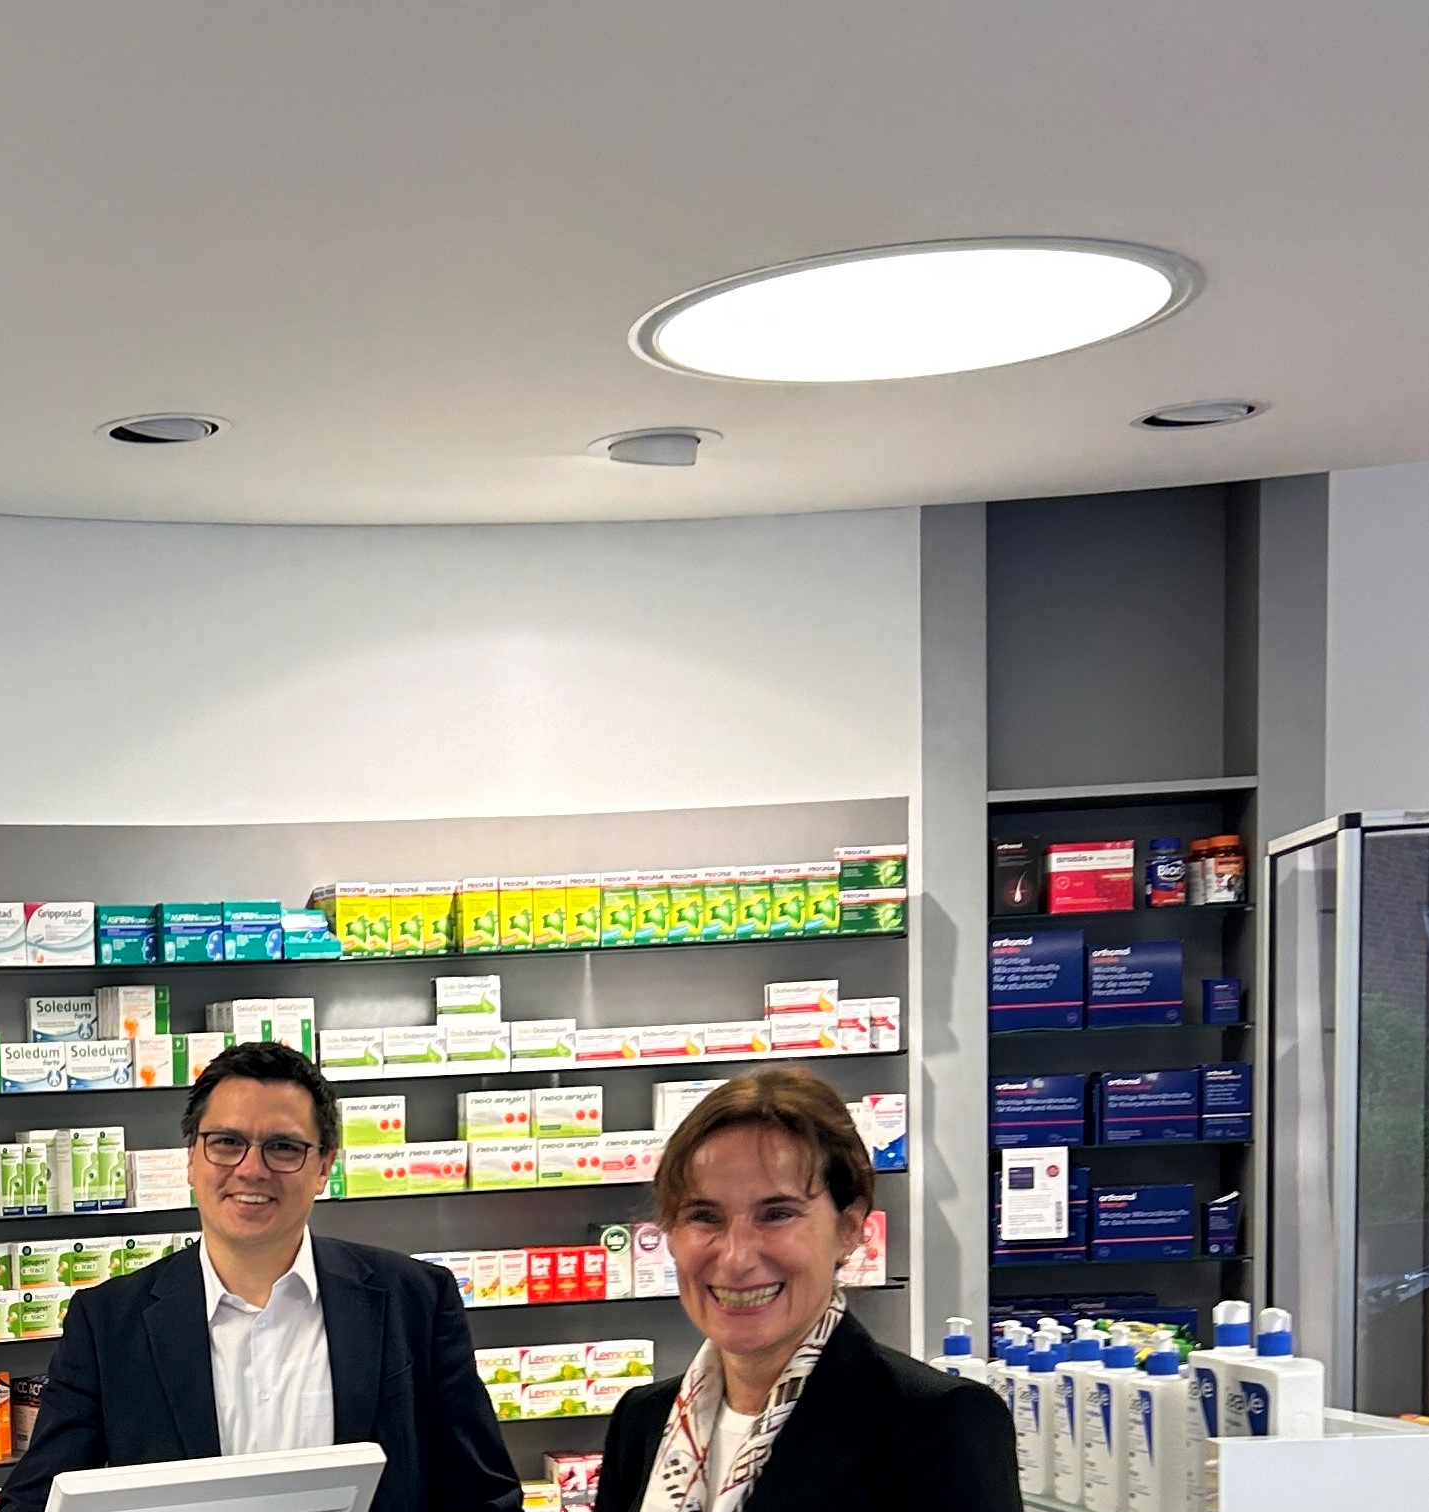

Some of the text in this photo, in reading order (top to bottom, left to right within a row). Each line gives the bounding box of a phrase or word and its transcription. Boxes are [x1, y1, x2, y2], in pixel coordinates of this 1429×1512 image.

[38, 909, 82, 918] Grippostad
[36, 1000, 91, 1013] Soledum
[5, 1047, 60, 1060] Soledum
[71, 1046, 128, 1057] Soledum
[529, 1353, 580, 1364] Lemocin
[594, 1349, 646, 1361] Lemocin
[477, 1356, 514, 1368] mocin
[529, 1386, 580, 1399] Lemocin
